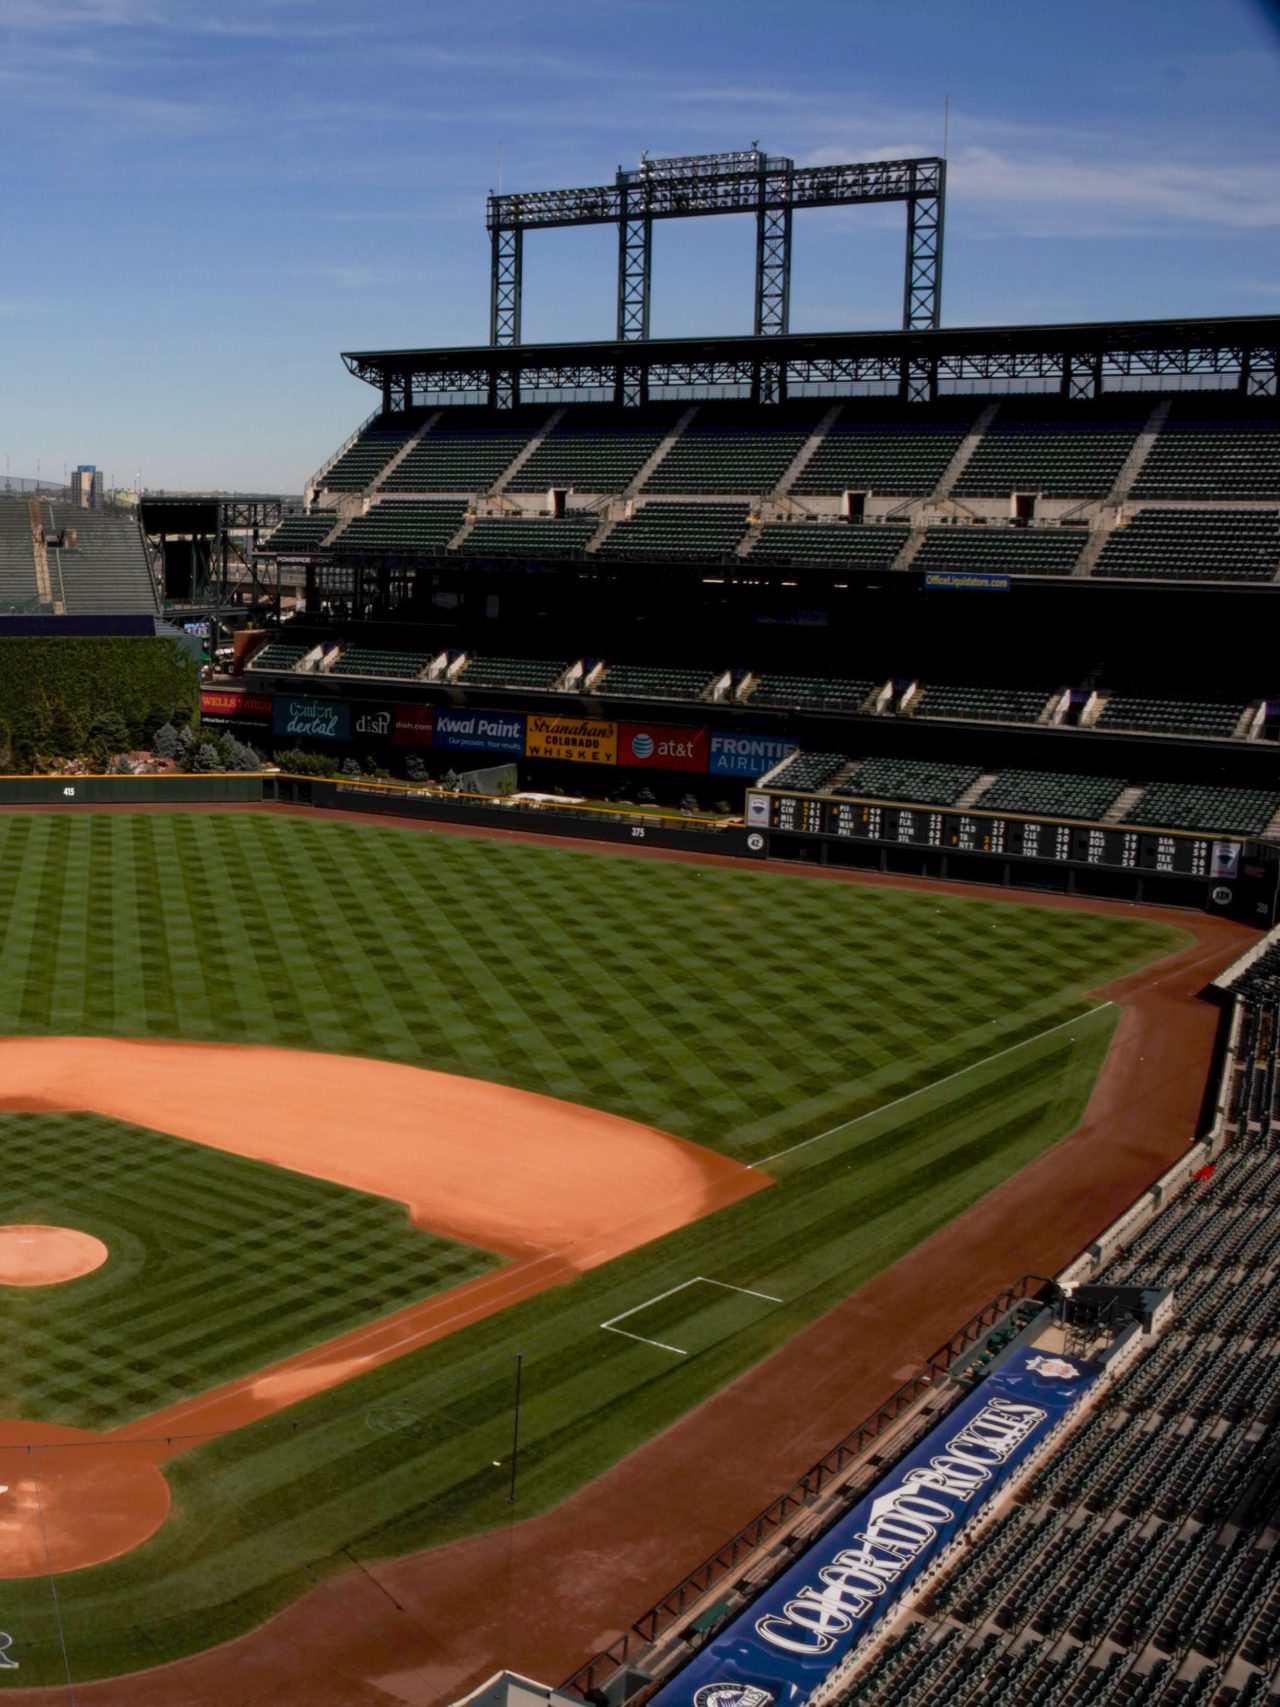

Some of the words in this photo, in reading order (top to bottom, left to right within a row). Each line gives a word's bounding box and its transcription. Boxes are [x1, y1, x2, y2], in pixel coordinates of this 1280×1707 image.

[927, 575, 1008, 589] OfficeLiquidators.com
[202, 696, 237, 708] WELLS
[290, 700, 334, 719] Comfort
[287, 715, 338, 736] dental
[356, 712, 391, 734] dish
[396, 721, 432, 731] dish.com
[437, 716, 475, 733] Kwal
[477, 719, 521, 738] Paint
[529, 717, 615, 738] Stranahan's
[545, 735, 600, 749] COLORADO
[529, 745, 613, 762] WHISKEY
[658, 739, 694, 758] at&t
[711, 738, 796, 758] FRONTIE
[717, 755, 778, 772] AIRLIN
[63, 787, 75, 796] 415
[781, 806, 794, 815] CIN
[780, 814, 793, 823] MIL
[632, 827, 645, 838] 375
[780, 822, 794, 831] CHC
[809, 825, 819, 833] 17
[898, 827, 914, 836] NYM
[960, 825, 977, 834] LAD
[992, 828, 1005, 836] 37
[1024, 824, 1040, 832] CWS
[1024, 831, 1037, 840] CLE
[1056, 835, 1070, 843] 30
[1089, 830, 1104, 838] BAL
[751, 838, 761, 848] 42
[1023, 840, 1038, 848] LAA
[1090, 838, 1105, 847] BOS
[1158, 837, 1174, 846] SEA
[1022, 848, 1037, 857] TOR
[1089, 847, 1103, 856] DET
[1122, 851, 1136, 859] 37
[1158, 845, 1176, 854] MIN
[1088, 855, 1099, 864] KC
[1157, 854, 1173, 863] TEX
[1156, 863, 1174, 872] OAK
[754, 1491, 955, 1655] COLORADO
[902, 1398, 1048, 1502] ROCKIES
